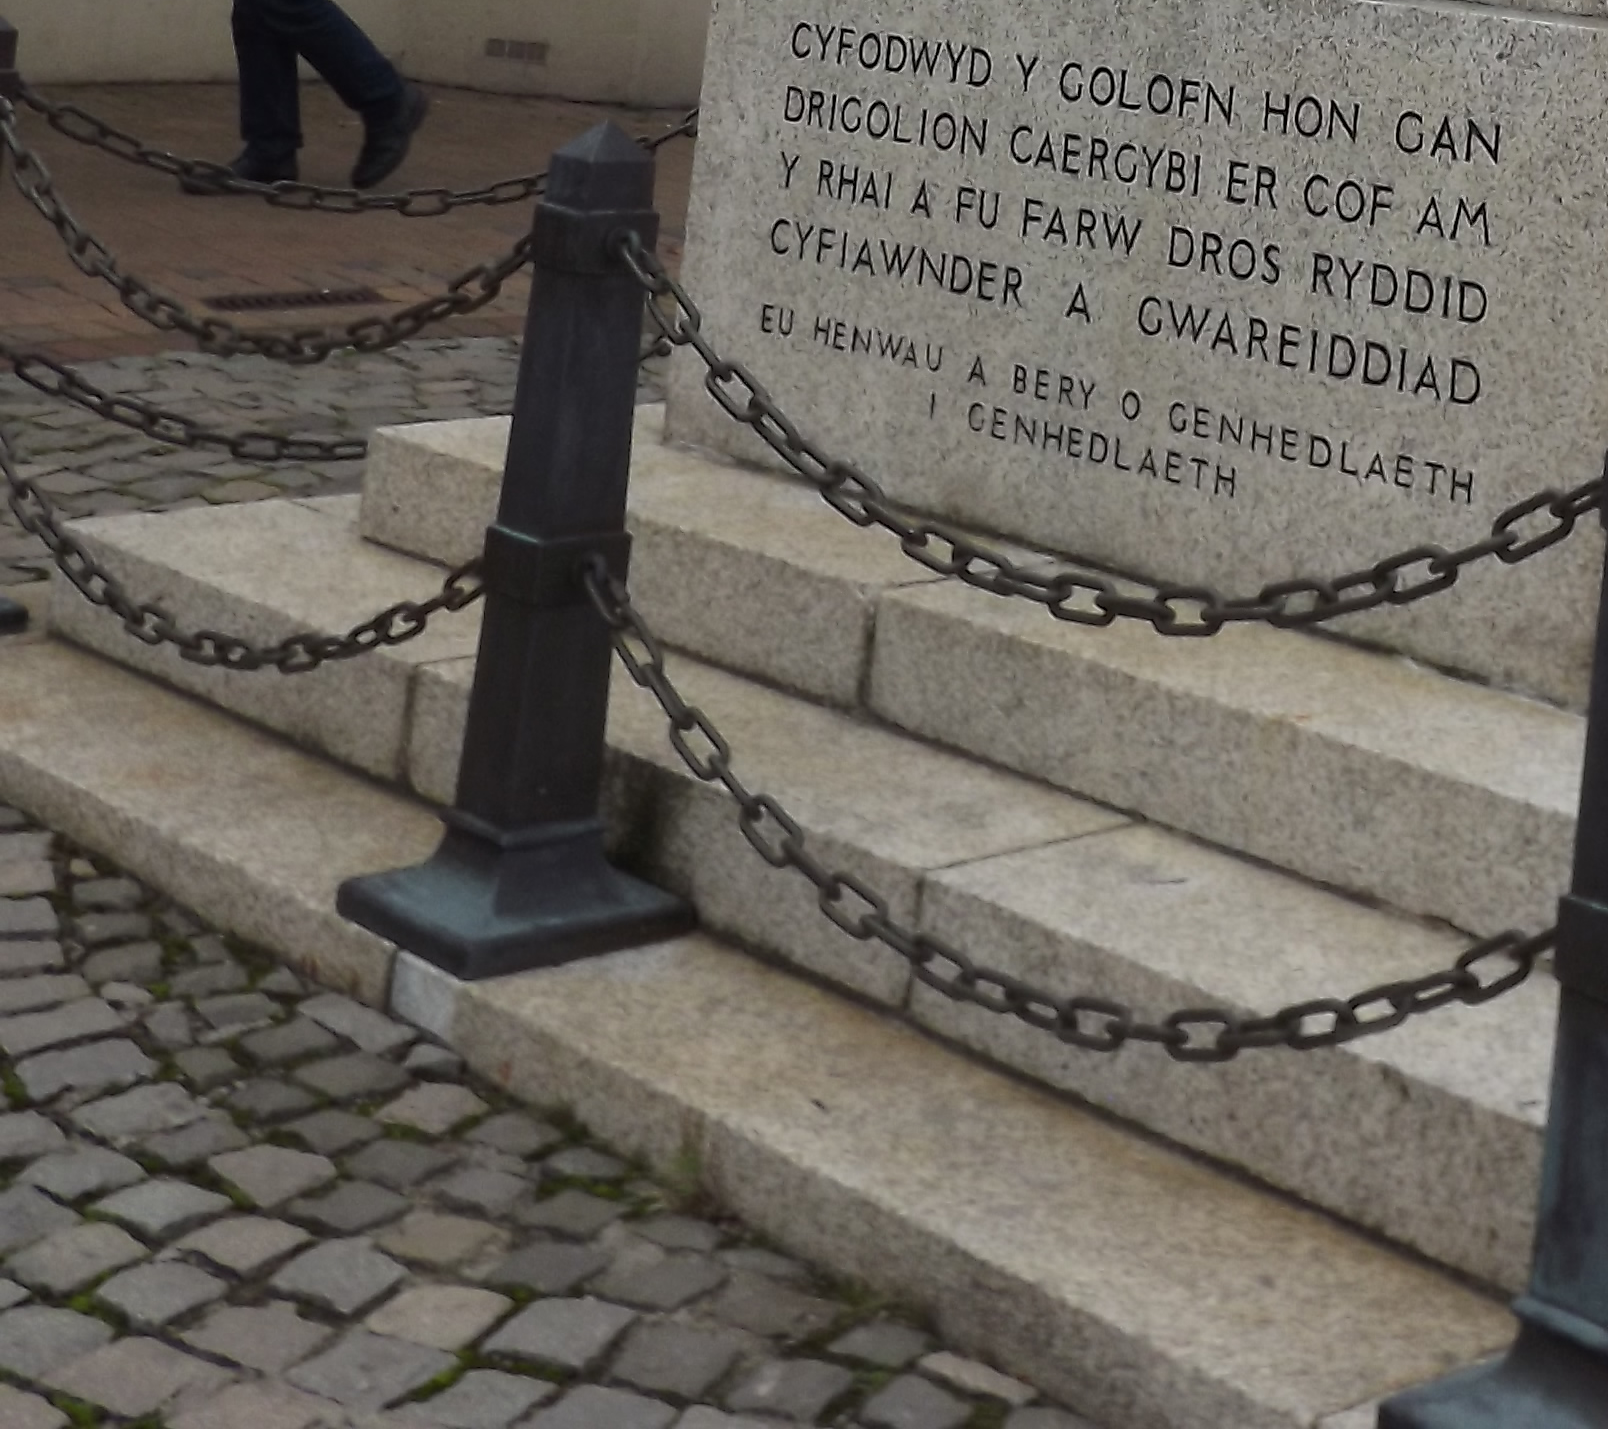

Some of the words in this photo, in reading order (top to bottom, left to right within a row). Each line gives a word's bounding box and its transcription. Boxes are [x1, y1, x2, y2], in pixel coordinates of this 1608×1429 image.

[783, 85, 989, 156] DRIGOLION
[1009, 125, 1202, 198] CAERGYBI
[1225, 159, 1278, 213] ER
[1302, 173, 1397, 228] COF
[1416, 196, 1495, 248] AM
[789, 21, 993, 89] CYFODWYD
[1015, 54, 1041, 93] Y
[1058, 61, 1238, 127] GOLOFN
[1262, 92, 1362, 143] HON
[1395, 109, 1504, 166] GAN
[769, 218, 1024, 309] CYFIAWNDER
[1066, 283, 1093, 325] A
[1137, 294, 1483, 408] GWAREIDDIAD
[779, 151, 802, 189] Y
[816, 158, 894, 211] RHAI
[909, 180, 934, 220] A
[955, 187, 1000, 230] FU
[1021, 198, 1143, 257] FARW
[1167, 225, 1282, 287] DROS
[1310, 253, 1490, 326] RYDDID
[759, 304, 795, 339] EU
[813, 314, 945, 376] HENWAU
[967, 355, 989, 388] A
[1012, 364, 1097, 414] BERY
[1120, 389, 1141, 422] O
[1168, 402, 1477, 505] GENHEDLAETH
[927, 393, 936, 420] I
[967, 402, 1238, 500] GENHEDLAETH
